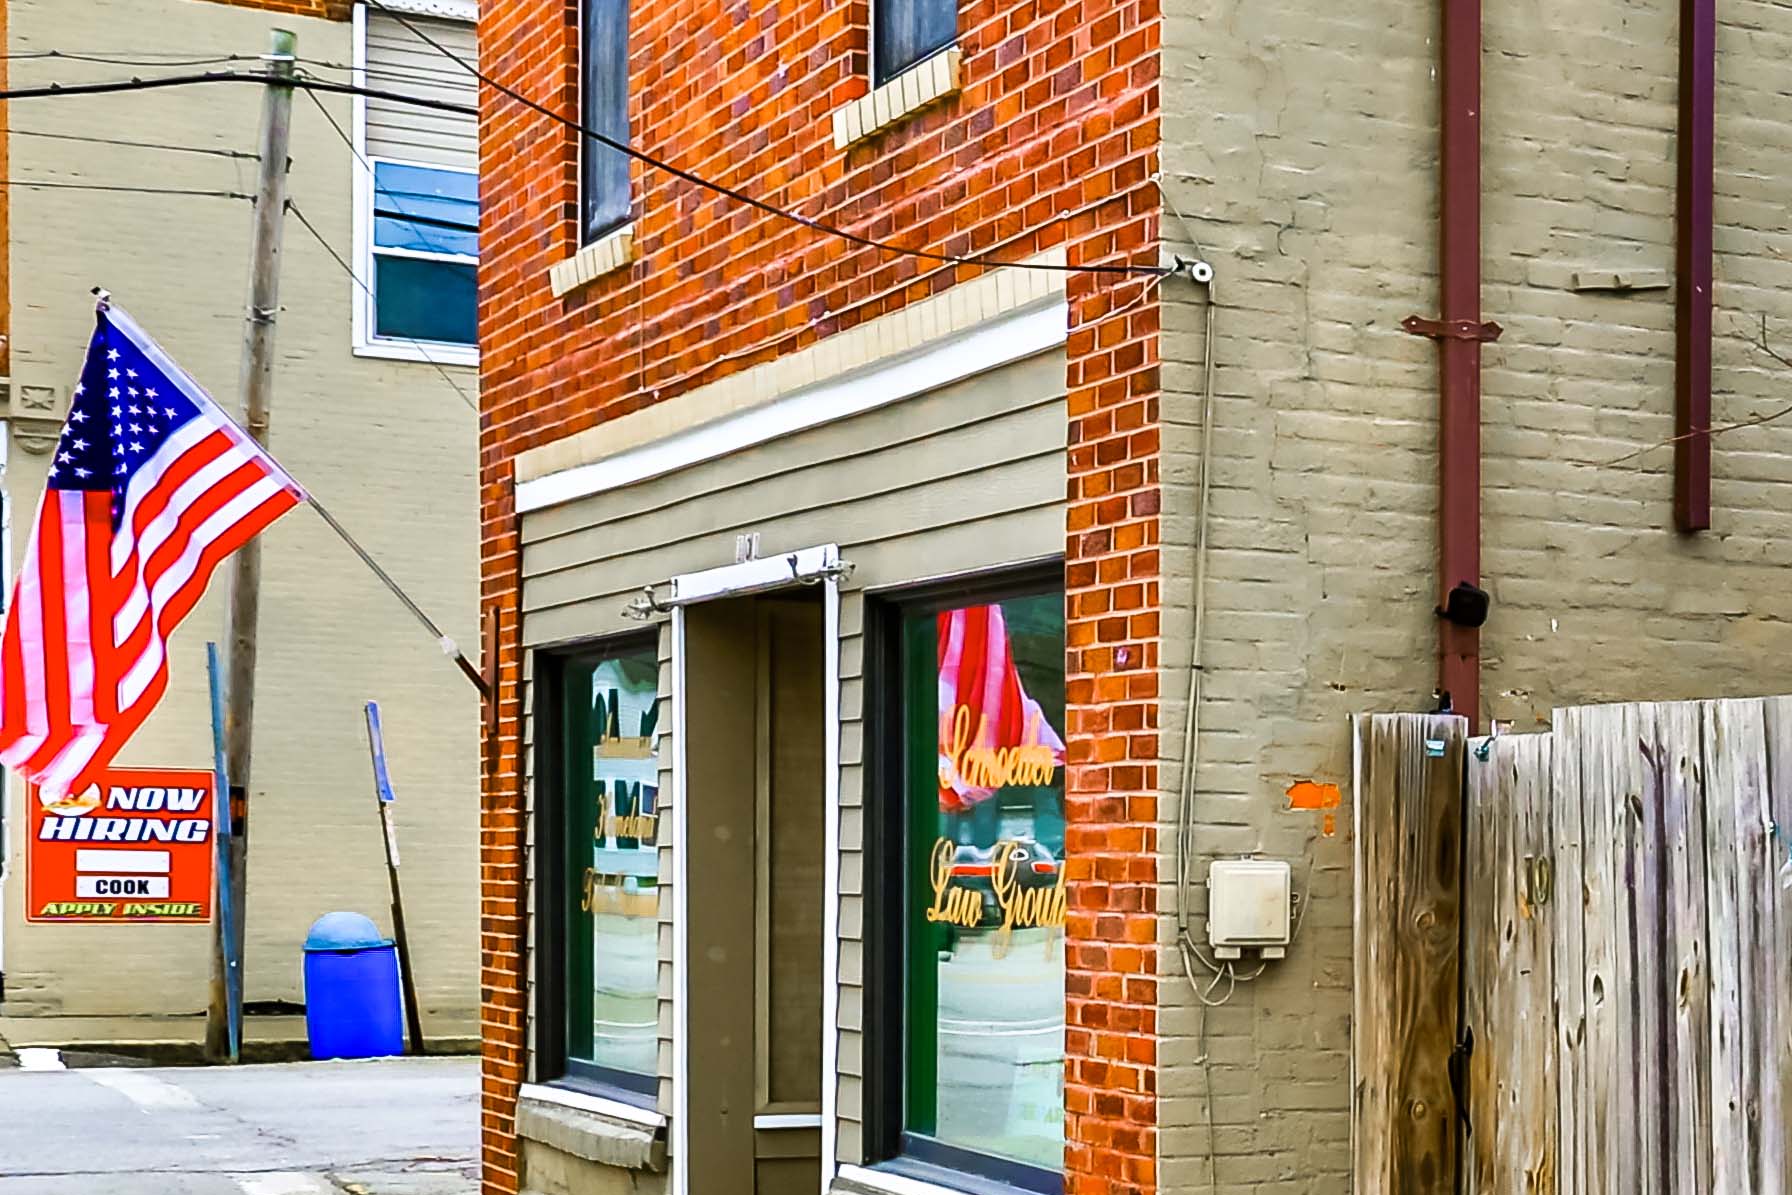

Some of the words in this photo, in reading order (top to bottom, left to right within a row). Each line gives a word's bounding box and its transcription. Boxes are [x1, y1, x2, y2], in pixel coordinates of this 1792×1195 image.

[106, 786, 206, 811] NOW
[39, 816, 209, 842] HIRING
[95, 879, 150, 895] COOK
[927, 836, 983, 928] Law
[40, 902, 118, 916] APPLY
[122, 902, 203, 916] INSIDE
